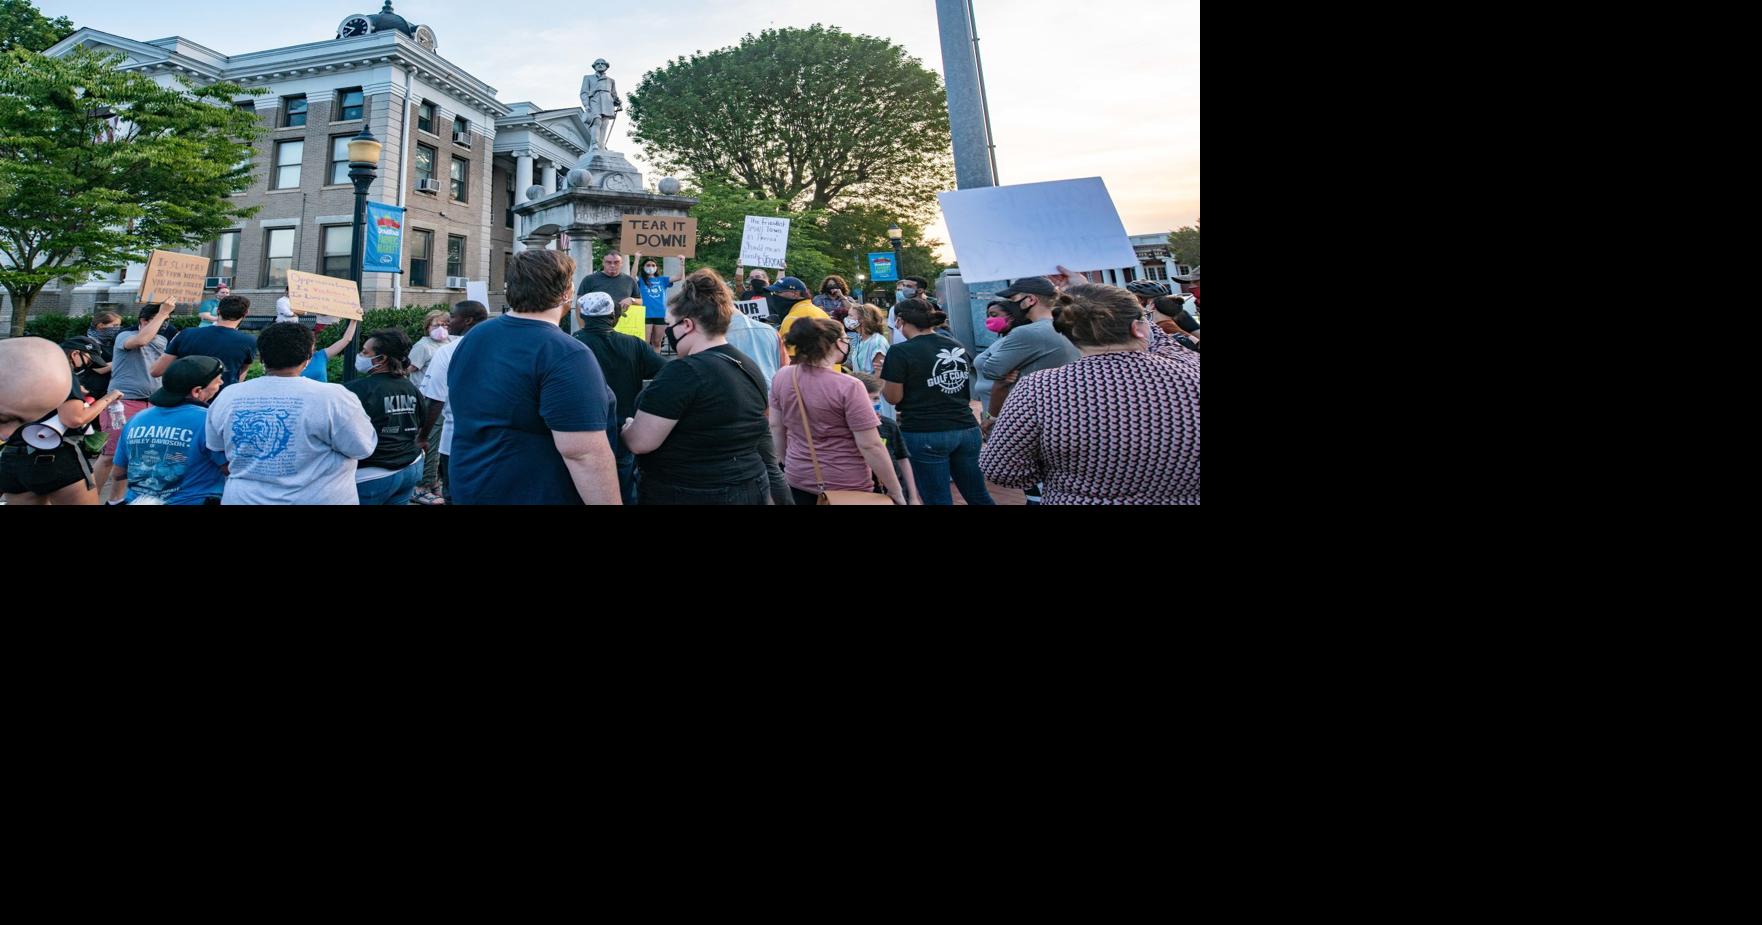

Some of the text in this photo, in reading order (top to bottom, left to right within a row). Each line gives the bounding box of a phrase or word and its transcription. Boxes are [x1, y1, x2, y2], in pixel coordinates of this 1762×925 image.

[629, 220, 686, 231] TEAR IT
[636, 233, 686, 248] DOWN!
[927, 371, 969, 387] GULF COAS
[384, 395, 417, 414] KING
[127, 425, 193, 442] ADAMEC
